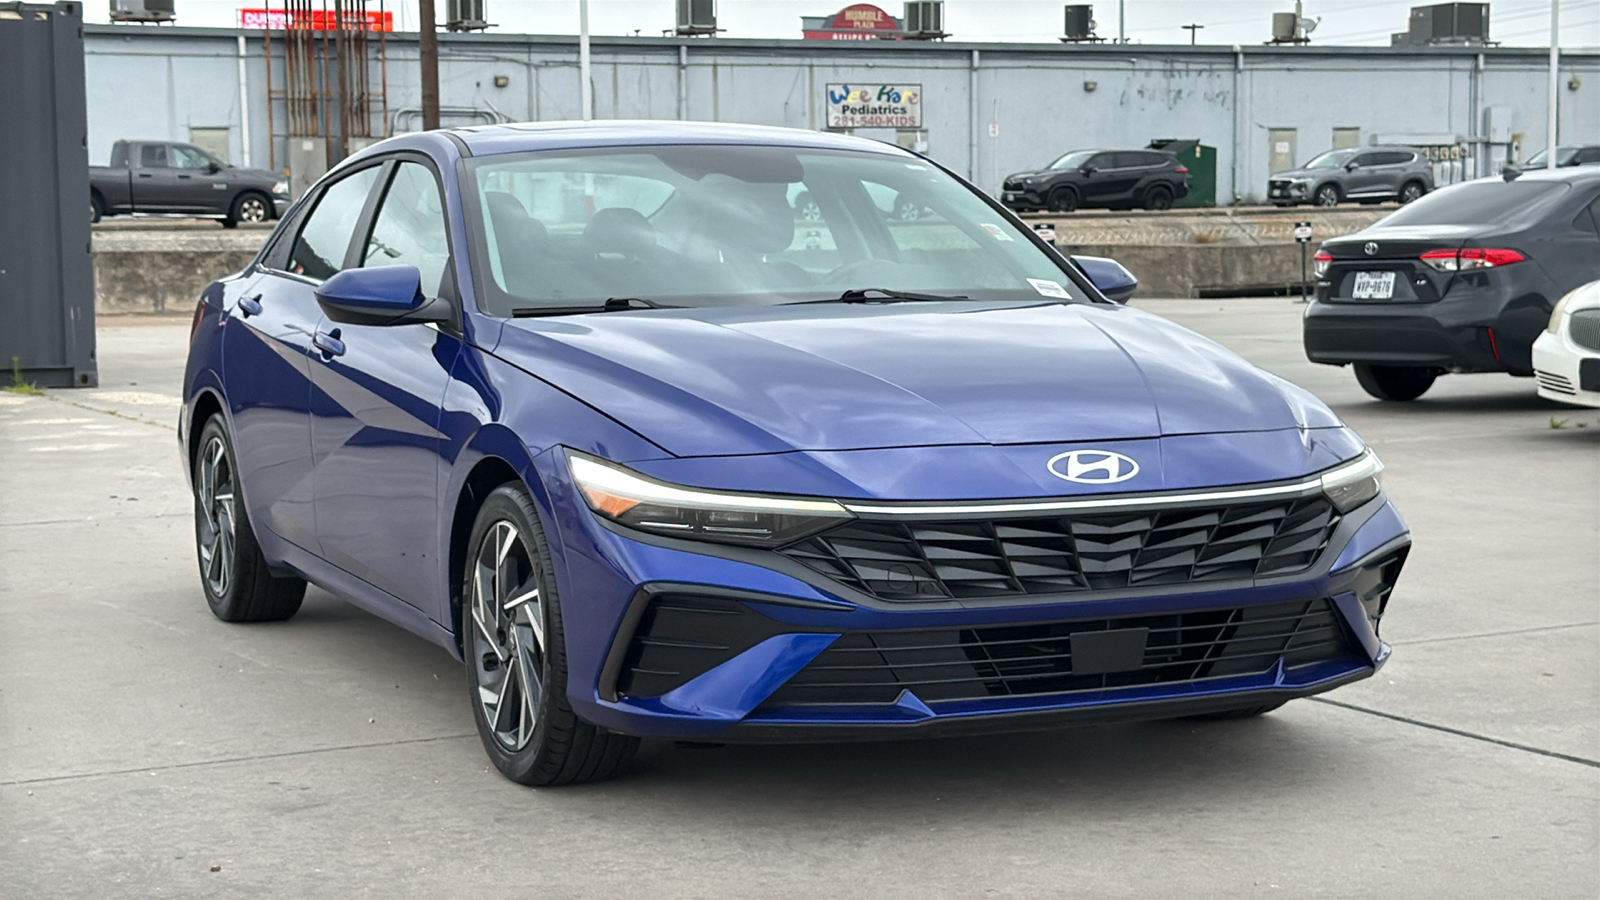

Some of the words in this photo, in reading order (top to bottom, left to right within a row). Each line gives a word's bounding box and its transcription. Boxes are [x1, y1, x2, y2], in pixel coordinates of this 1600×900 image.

[829, 84, 871, 105] Wee
[876, 85, 919, 105] Kare
[842, 104, 907, 115] Pediatrics
